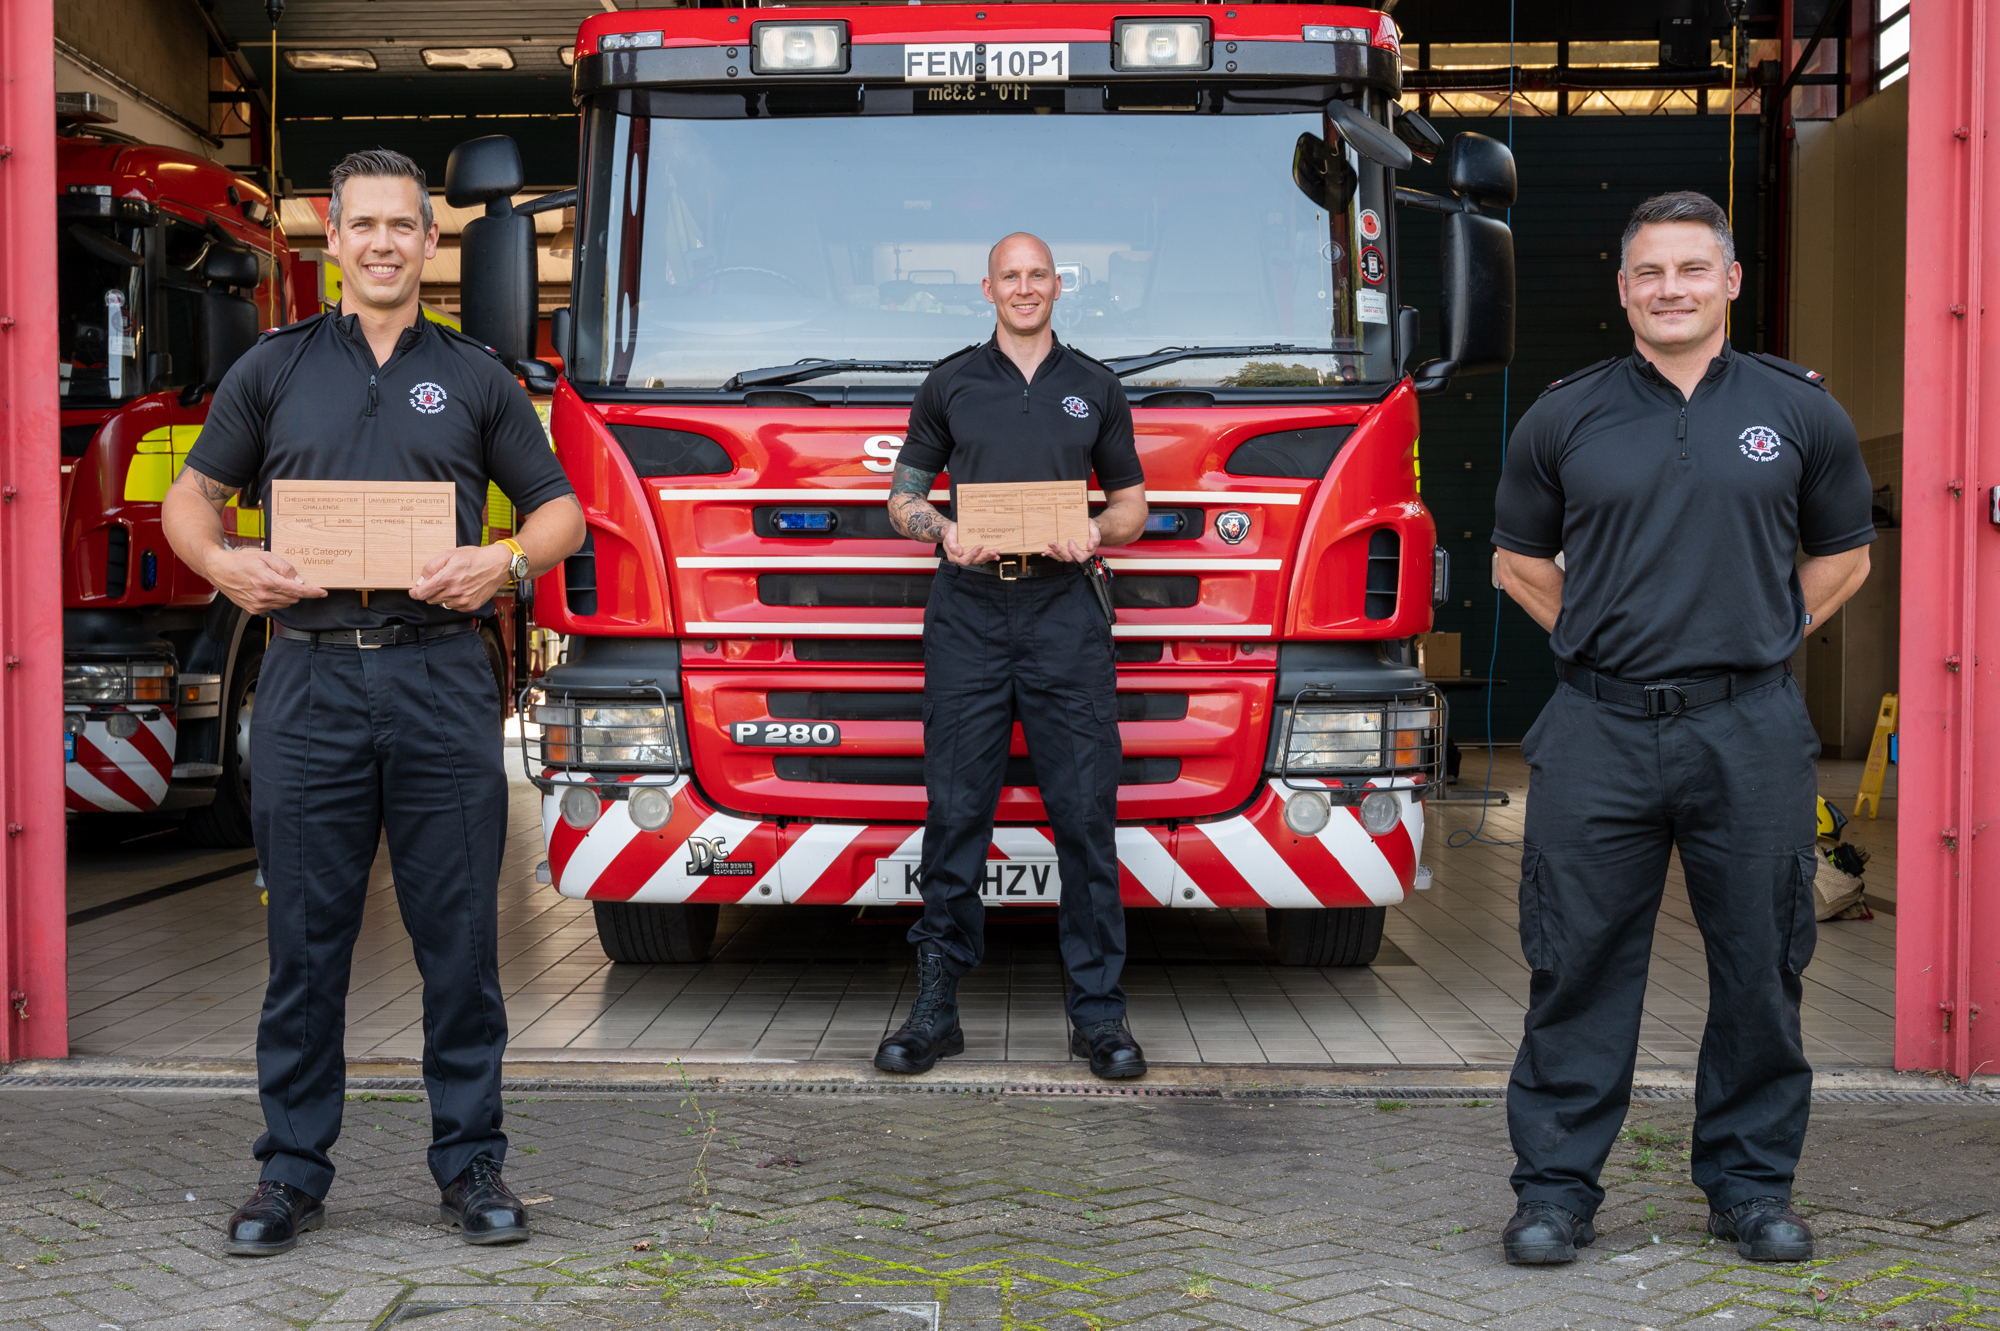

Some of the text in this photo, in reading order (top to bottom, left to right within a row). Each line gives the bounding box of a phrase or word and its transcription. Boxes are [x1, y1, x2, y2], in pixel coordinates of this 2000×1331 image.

[906, 50, 1063, 77] FEM 10P1
[415, 406, 427, 414] and
[1747, 453, 1760, 462] and
[284, 547, 353, 558] 40-45 Category
[302, 557, 335, 565] Winner
[736, 723, 835, 744] P 280
[713, 862, 729, 870] JOHN
[981, 864, 1051, 896] HZV
